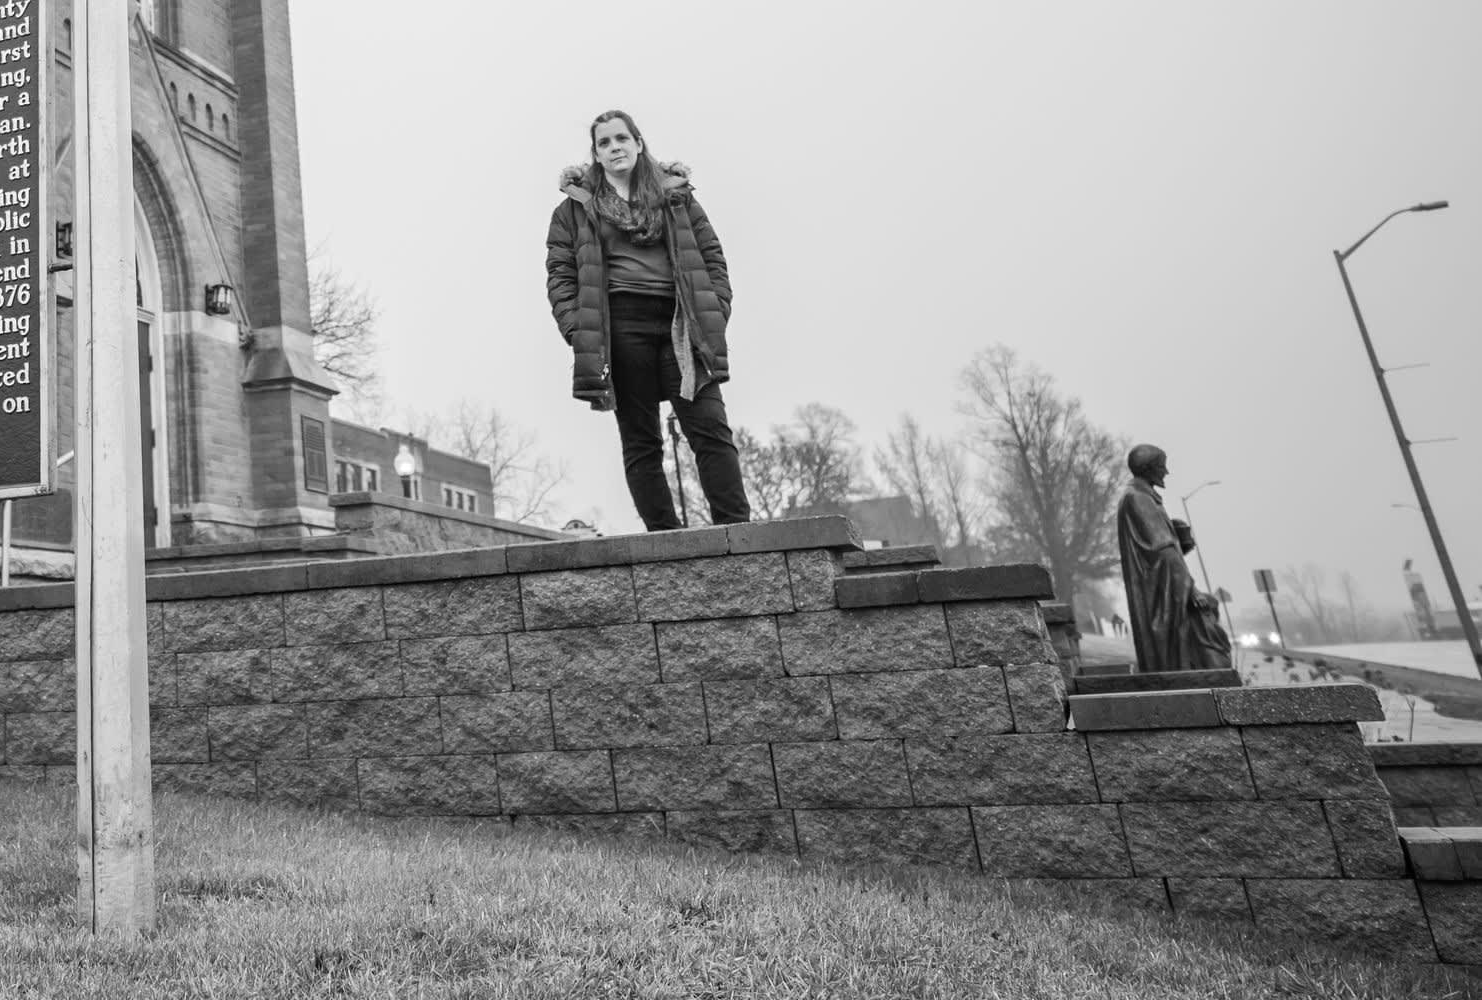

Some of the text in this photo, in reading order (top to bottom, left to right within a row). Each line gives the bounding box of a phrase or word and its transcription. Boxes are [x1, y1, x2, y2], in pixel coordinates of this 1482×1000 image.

[17, 91, 31, 106] a
[8, 158, 31, 181] at
[9, 235, 31, 255] in
[2, 396, 31, 413] on
